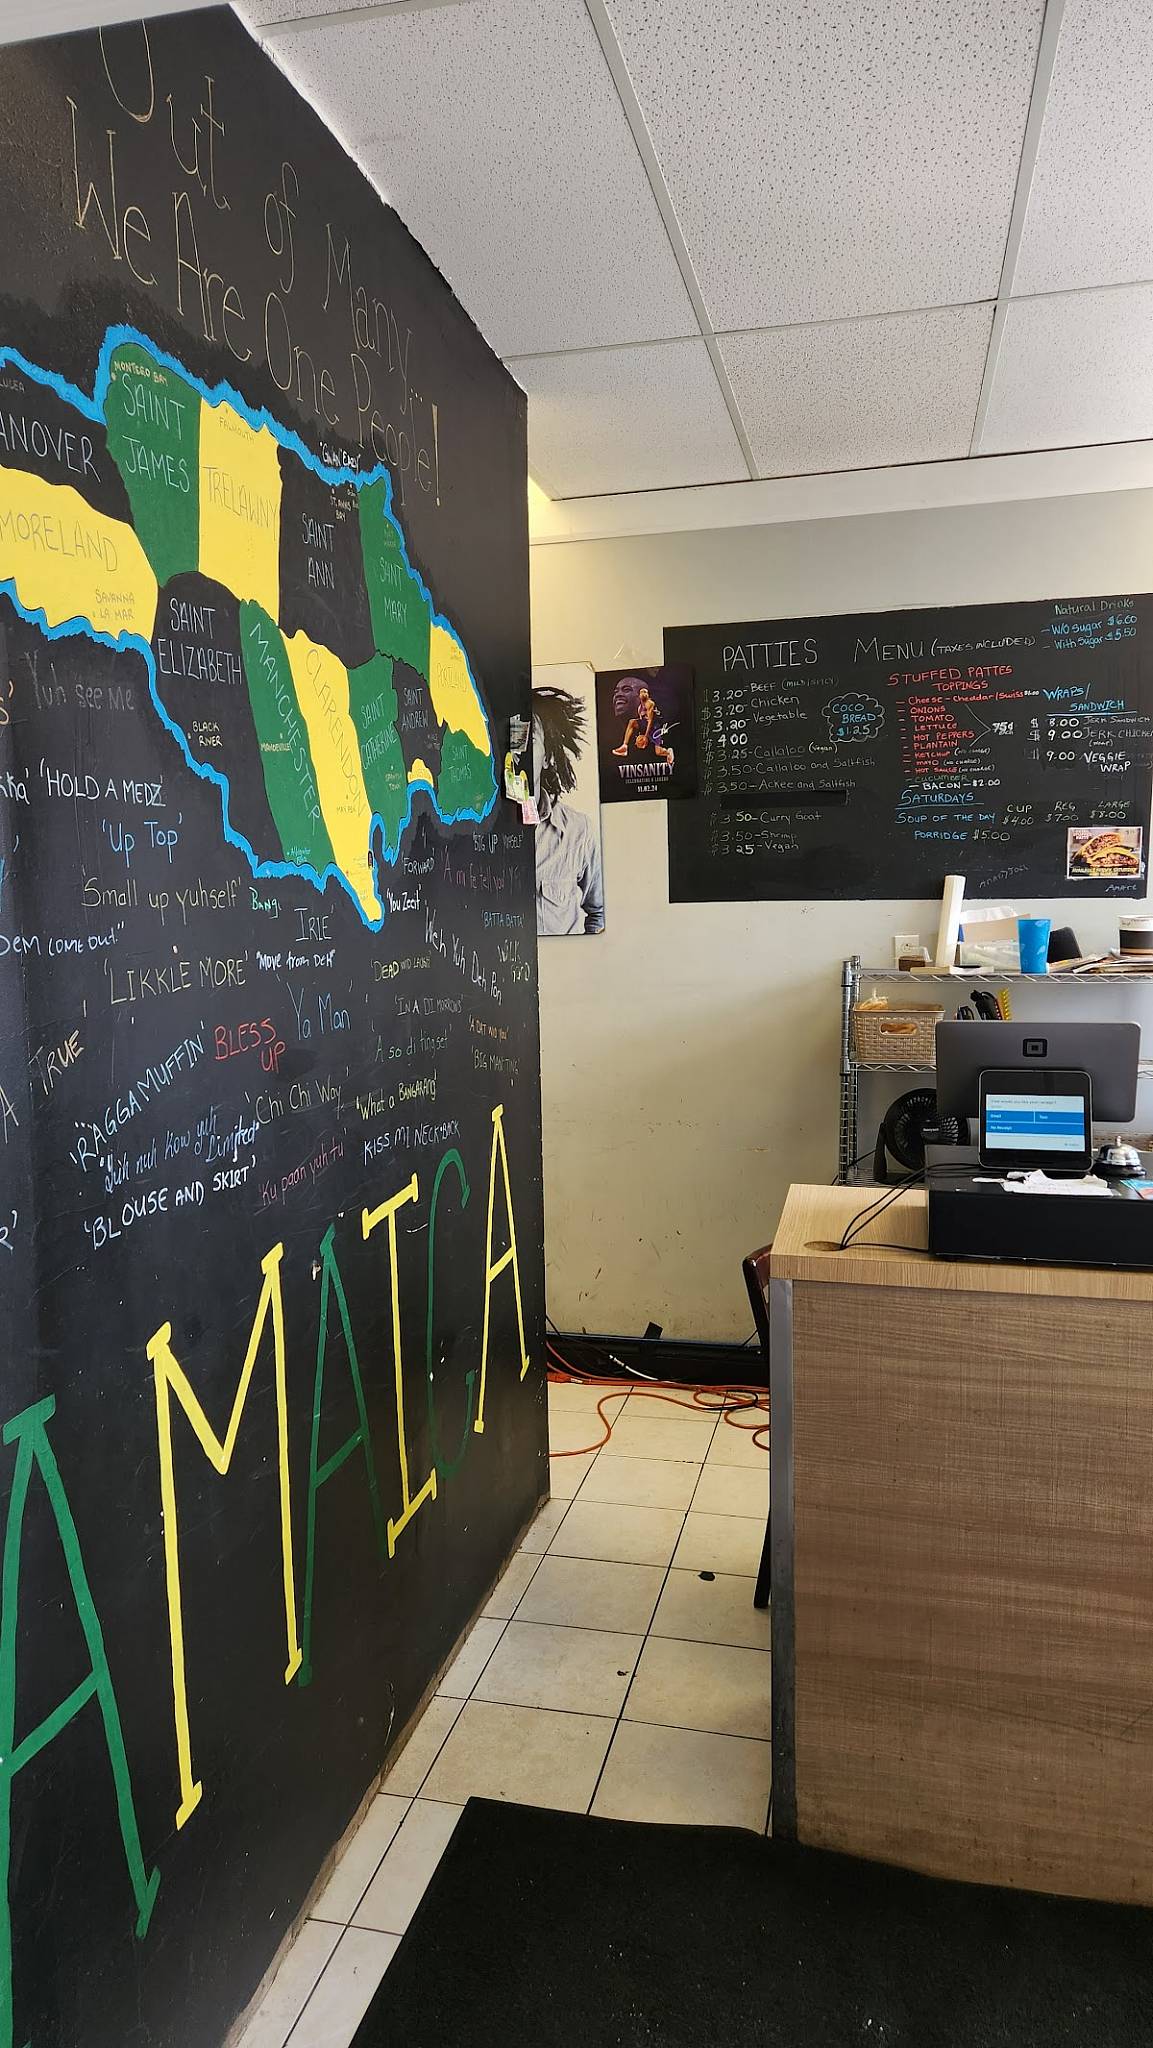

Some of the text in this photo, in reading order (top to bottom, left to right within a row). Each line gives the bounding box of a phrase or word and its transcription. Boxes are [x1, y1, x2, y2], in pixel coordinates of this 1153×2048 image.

[264, 161, 299, 294] of
[66, 95, 442, 507] We Are One People!
[122, 373, 186, 441] SAINT
[122, 434, 190, 493] JAMES
[202, 466, 280, 542] TRELAWNY
[302, 512, 334, 553] SAINT
[308, 557, 335, 589] ANN
[95, 589, 135, 604] SAVANNA
[384, 598, 408, 628] MARY
[1055, 598, 1134, 616] Natural Drinks
[170, 597, 216, 639] SAINT
[722, 638, 818, 671] PATTIES
[853, 637, 924, 663] MENU
[157, 638, 242, 685] ELIZABETH
[888, 668, 962, 686] STUFFED
[932, 680, 989, 692] TOPPINGS
[76, 683, 103, 710] see
[403, 687, 423, 706] SAINT
[750, 682, 777, 692] BEEF
[360, 692, 384, 730] SAINT
[751, 695, 800, 708] Chicken
[910, 705, 946, 714] ONIONS
[1069, 700, 1125, 712] SANDWICH
[401, 710, 429, 731] ANDREW
[753, 708, 808, 726] Vegetable
[832, 704, 876, 723] COCO BREAD
[911, 714, 955, 723] TOMATO
[192, 720, 219, 732] BLACK
[250, 623, 321, 835] MANCHESTER
[305, 648, 367, 817] CLARENDON
[913, 731, 975, 742] HOT PEPPERS
[913, 740, 958, 750] PLANTAIN
[1083, 751, 1126, 763] VEGGIE
[1100, 760, 1131, 772] WRAP
[617, 762, 675, 778] VINSANITY
[104, 778, 118, 801] A
[922, 779, 1001, 790] BACON $2.00
[900, 789, 975, 806] SATURDAYS
[1007, 804, 1033, 814] CUP
[1054, 801, 1076, 812] REG
[760, 811, 791, 824] Curry
[895, 813, 996, 824] SOUP OF THE DAY
[914, 829, 1011, 842] PORRIDGE $5.00
[765, 840, 799, 853] Vegan
[148, 891, 169, 926] up
[412, 999, 420, 1014] A
[214, 1018, 277, 1061] BLESS
[388, 1046, 402, 1060] so
[406, 1035, 416, 1056] di
[28, 1029, 85, 1096] TRUE
[261, 1041, 286, 1073] UP
[289, 1083, 312, 1111] Chi
[389, 1096, 396, 1109] a
[175, 1181, 205, 1206] AND
